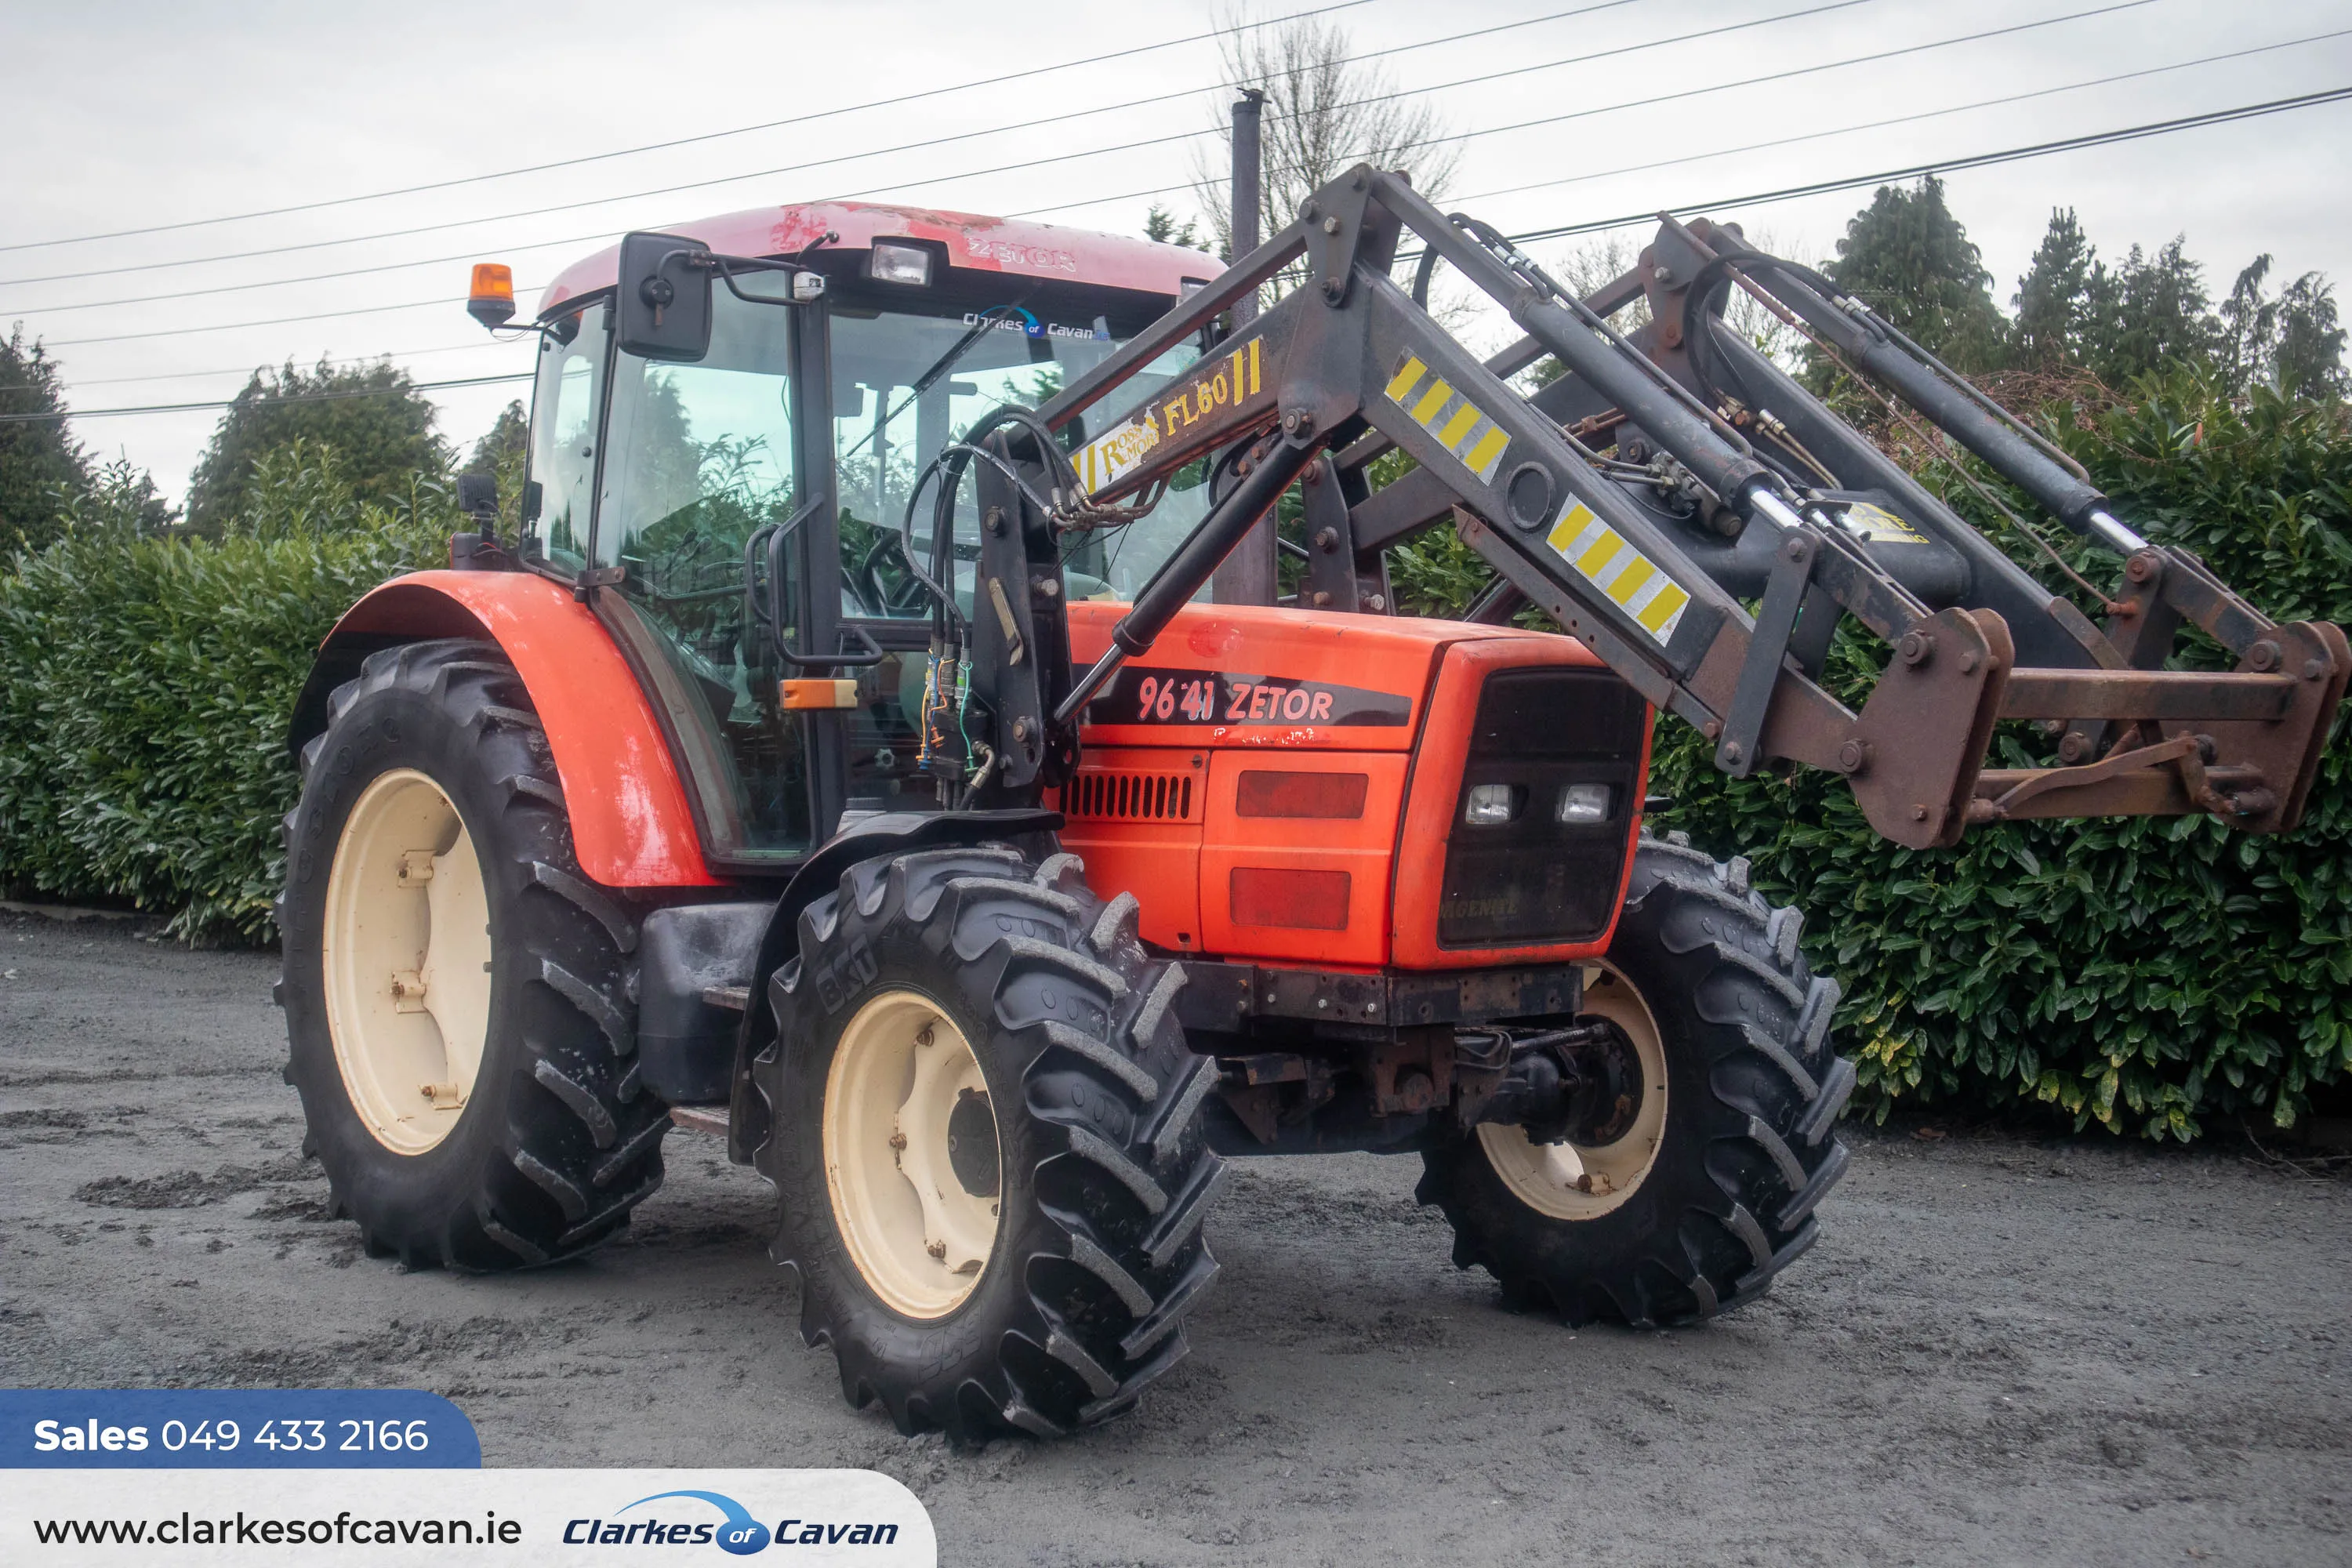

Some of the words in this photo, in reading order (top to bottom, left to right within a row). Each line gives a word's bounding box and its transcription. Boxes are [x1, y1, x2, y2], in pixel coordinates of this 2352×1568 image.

[1029, 325, 1040, 334] of
[1163, 373, 1228, 437] FL60
[1225, 684, 1333, 720] ZETOR
[816, 934, 879, 1014] BKT
